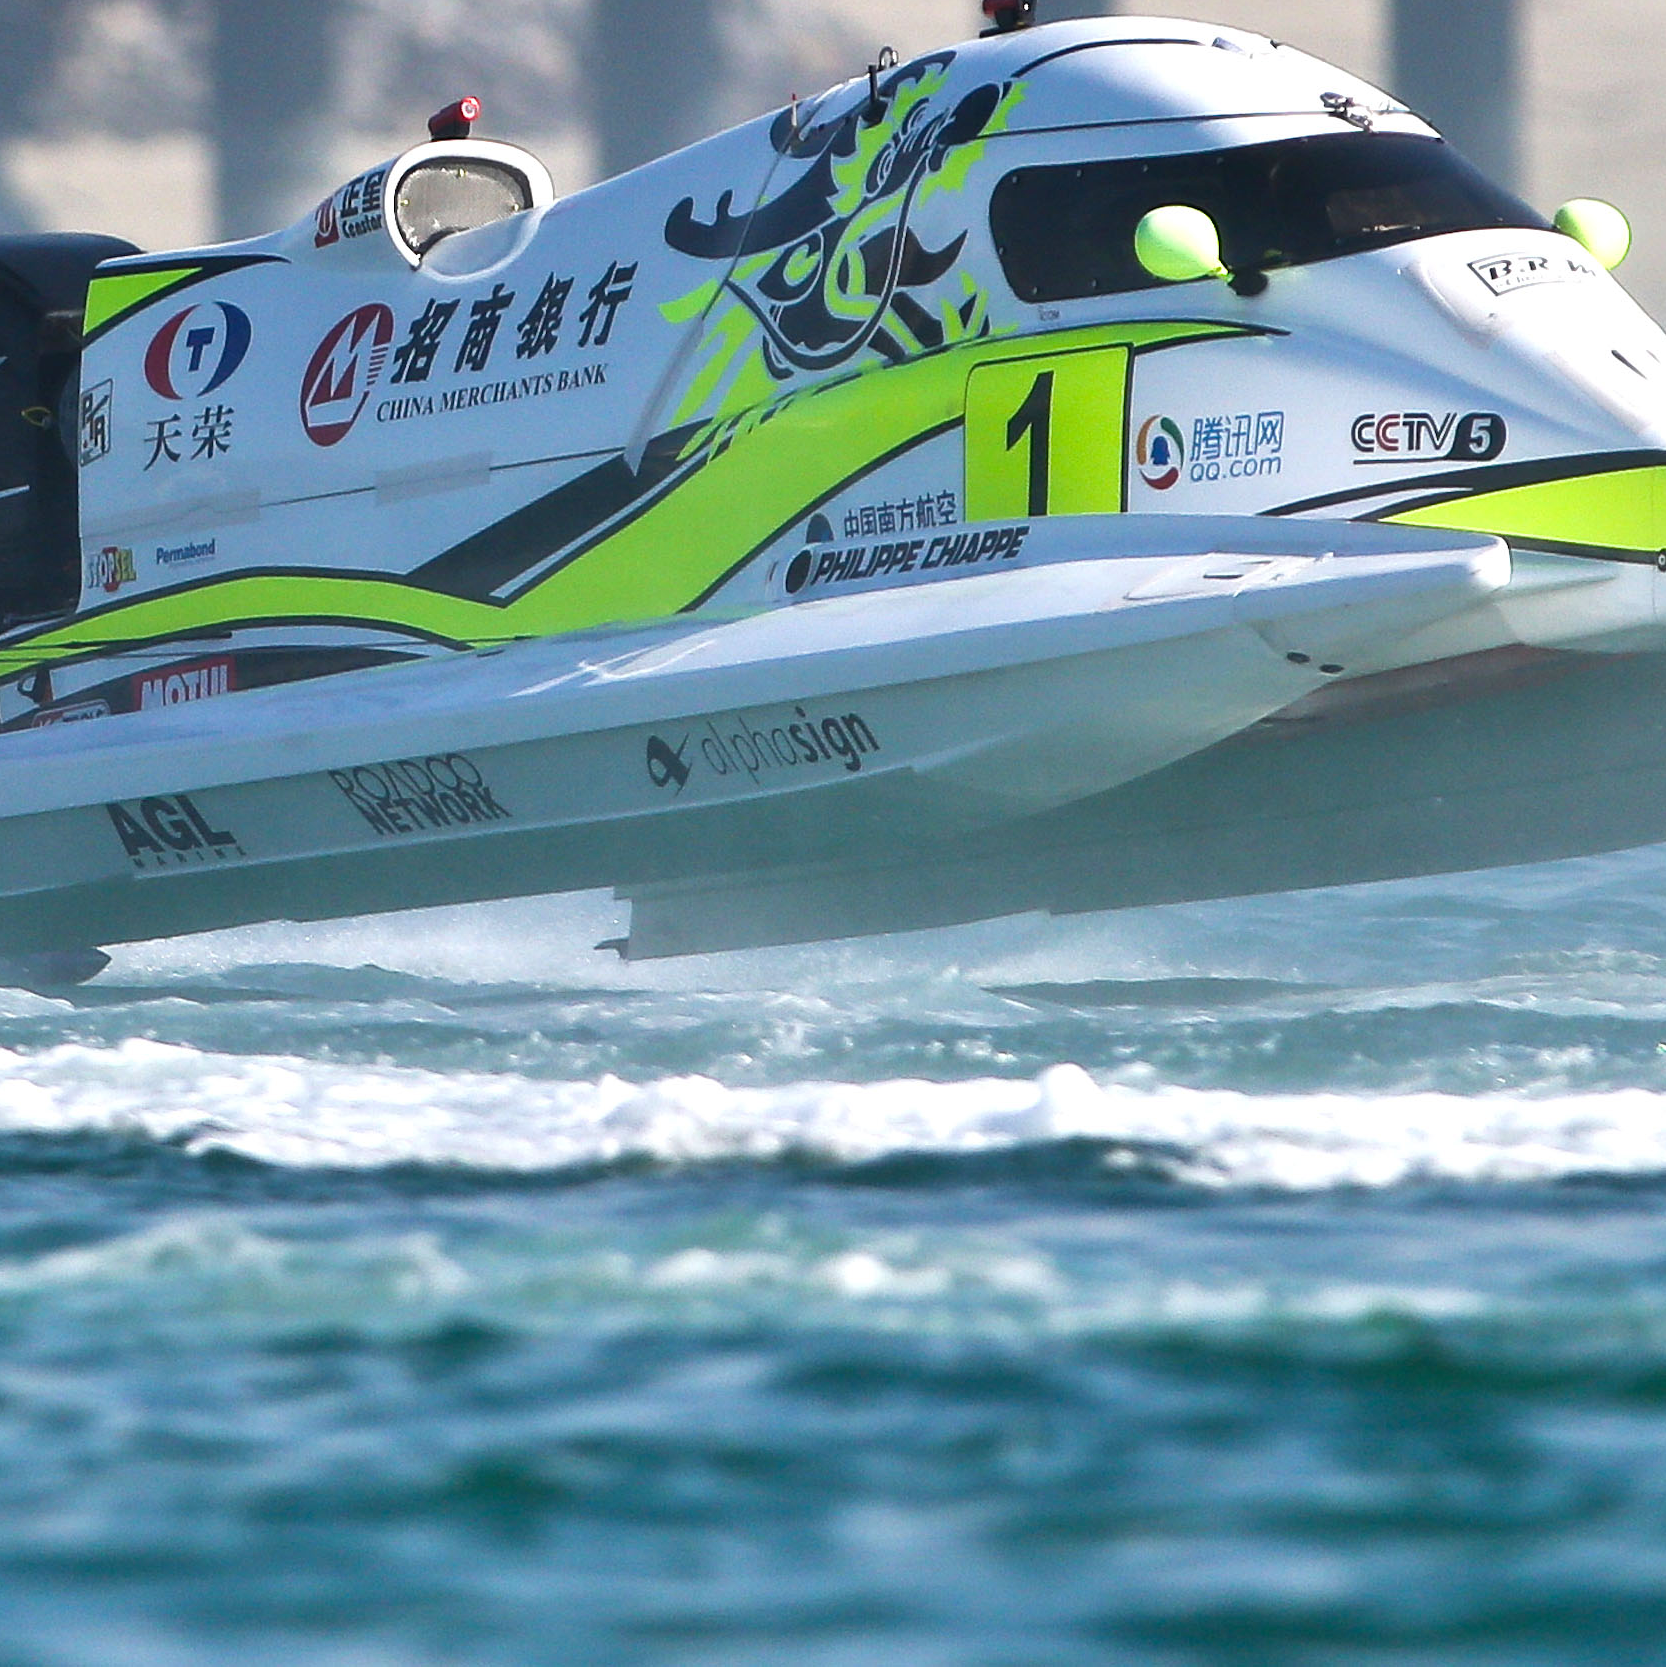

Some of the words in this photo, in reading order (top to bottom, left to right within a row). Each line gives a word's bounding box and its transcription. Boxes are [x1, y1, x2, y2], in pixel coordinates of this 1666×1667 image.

[376, 395, 434, 423] CHINA
[439, 373, 554, 413] MERCHANTS
[557, 363, 609, 392] BANK
[143, 404, 235, 472] 天荣
[1005, 369, 1055, 517] 1
[1190, 411, 1284, 461] 腾讯网
[1351, 412, 1458, 453] CCTV
[1468, 417, 1493, 454] 5
[1190, 456, 1282, 482] QQ.com
[843, 488, 958, 539] 中国南方航空
[155, 537, 216, 565] Permabond
[809, 539, 925, 586] PHILIPPE
[920, 525, 1031, 570] CHIAPPE
[701, 705, 881, 785] alphasign
[107, 794, 238, 856] AGL
[361, 785, 513, 836] NETWORK
